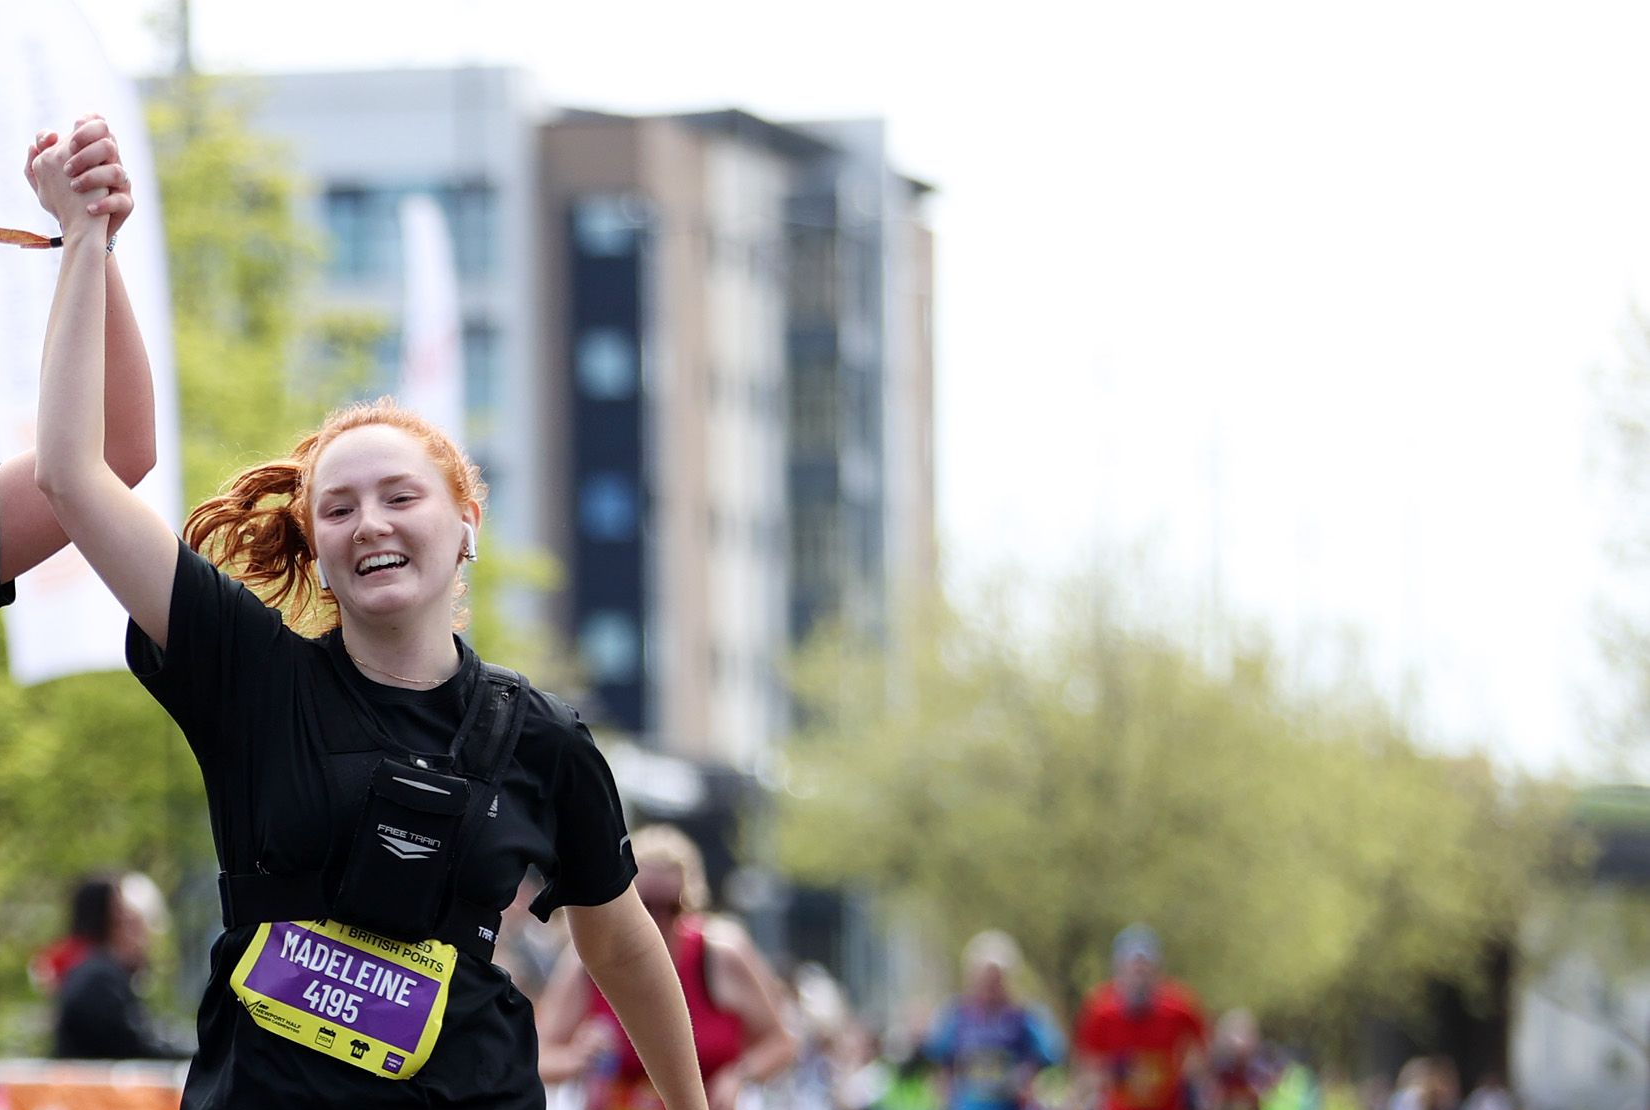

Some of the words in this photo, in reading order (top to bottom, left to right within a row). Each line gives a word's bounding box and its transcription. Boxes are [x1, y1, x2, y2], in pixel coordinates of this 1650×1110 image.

[377, 823, 408, 838] FREE
[409, 832, 441, 848] TRAIN
[348, 926, 400, 954] BRITISH
[402, 948, 444, 973] PORTS
[280, 930, 418, 1007] MADELEINE
[255, 1008, 286, 1023] NEWPORT
[302, 980, 363, 1024] 4195
[353, 1047, 362, 1056] M
